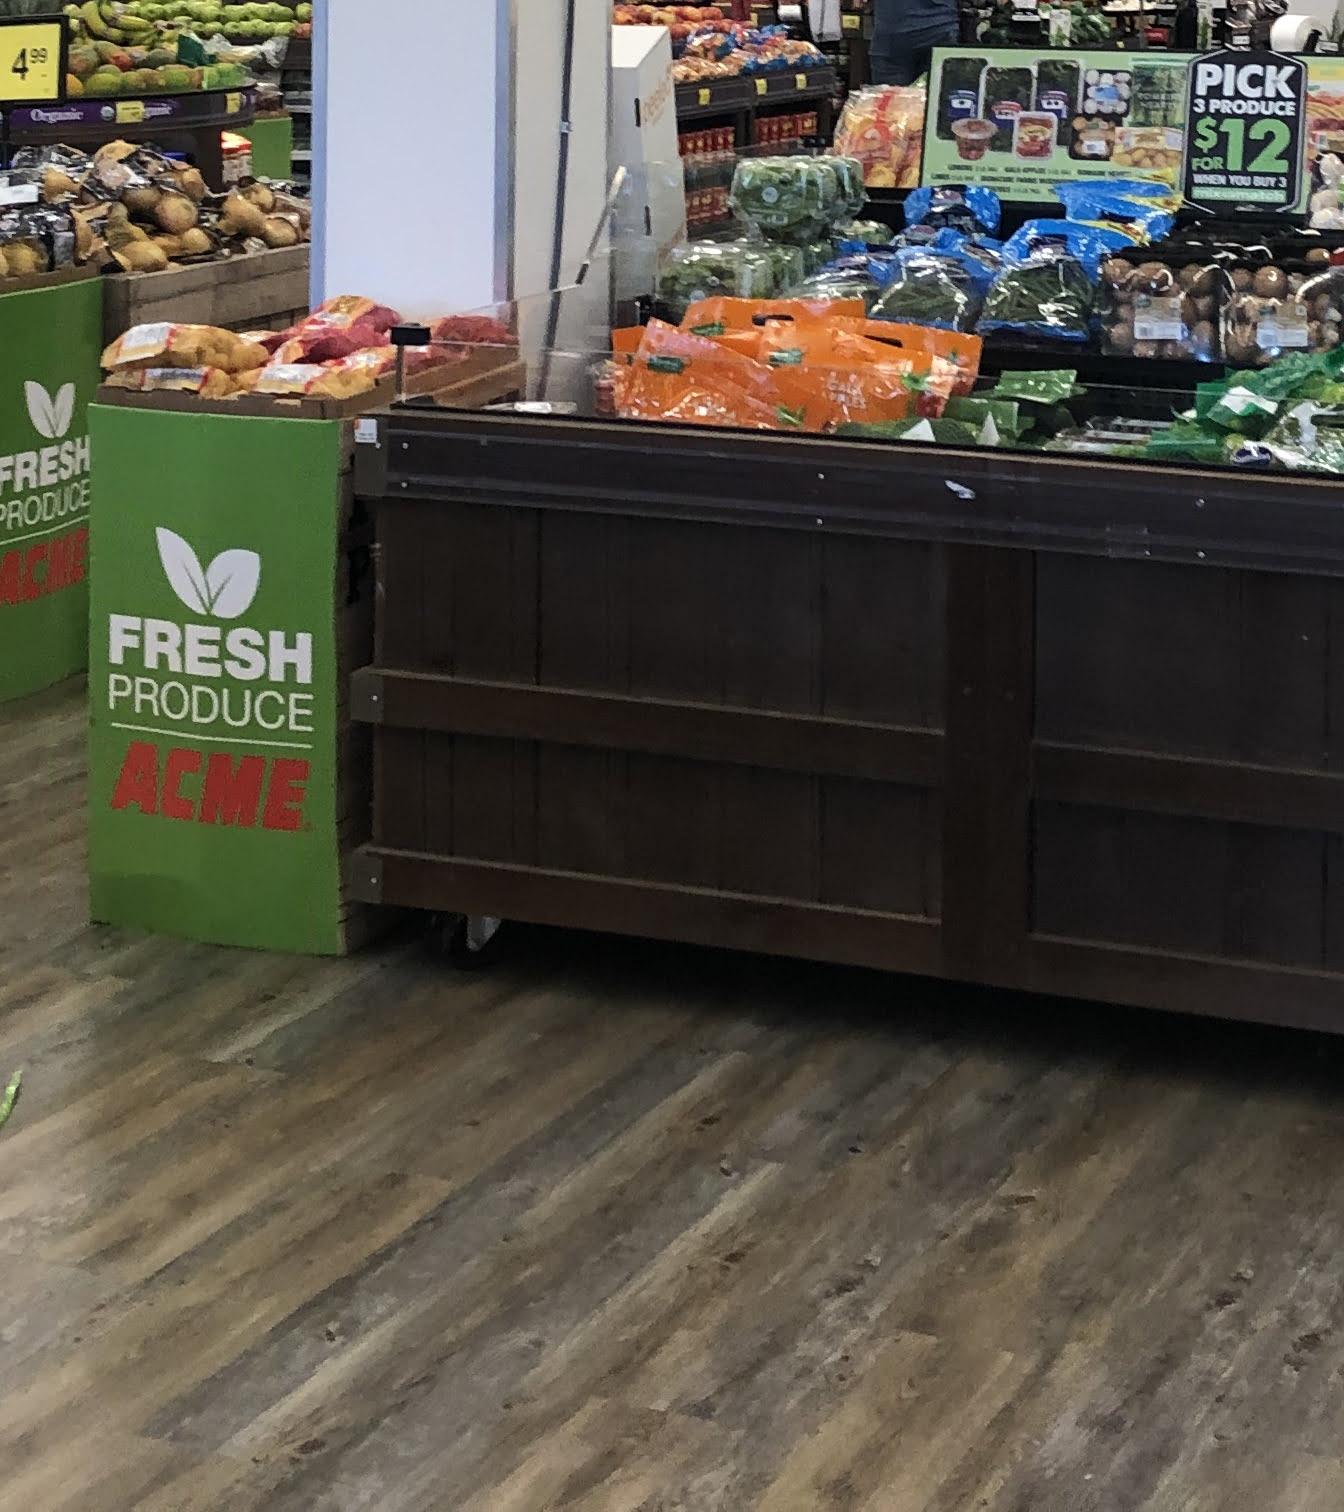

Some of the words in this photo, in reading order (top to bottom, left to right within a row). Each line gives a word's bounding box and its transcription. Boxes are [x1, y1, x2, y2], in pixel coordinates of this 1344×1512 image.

[1195, 63, 1297, 99] PICK
[31, 108, 84, 124] Organic
[1193, 99, 1206, 113] 3
[1209, 99, 1296, 116] PRODUCE
[1193, 116, 1291, 173] $12
[1191, 157, 1224, 171] FOR
[1228, 175, 1251, 186] YOU
[1253, 175, 1276, 187] BUY
[1279, 176, 1287, 187] 3
[108, 613, 313, 684] FRESH
[108, 673, 314, 732] PRODUCE
[110, 741, 311, 831] ACME
